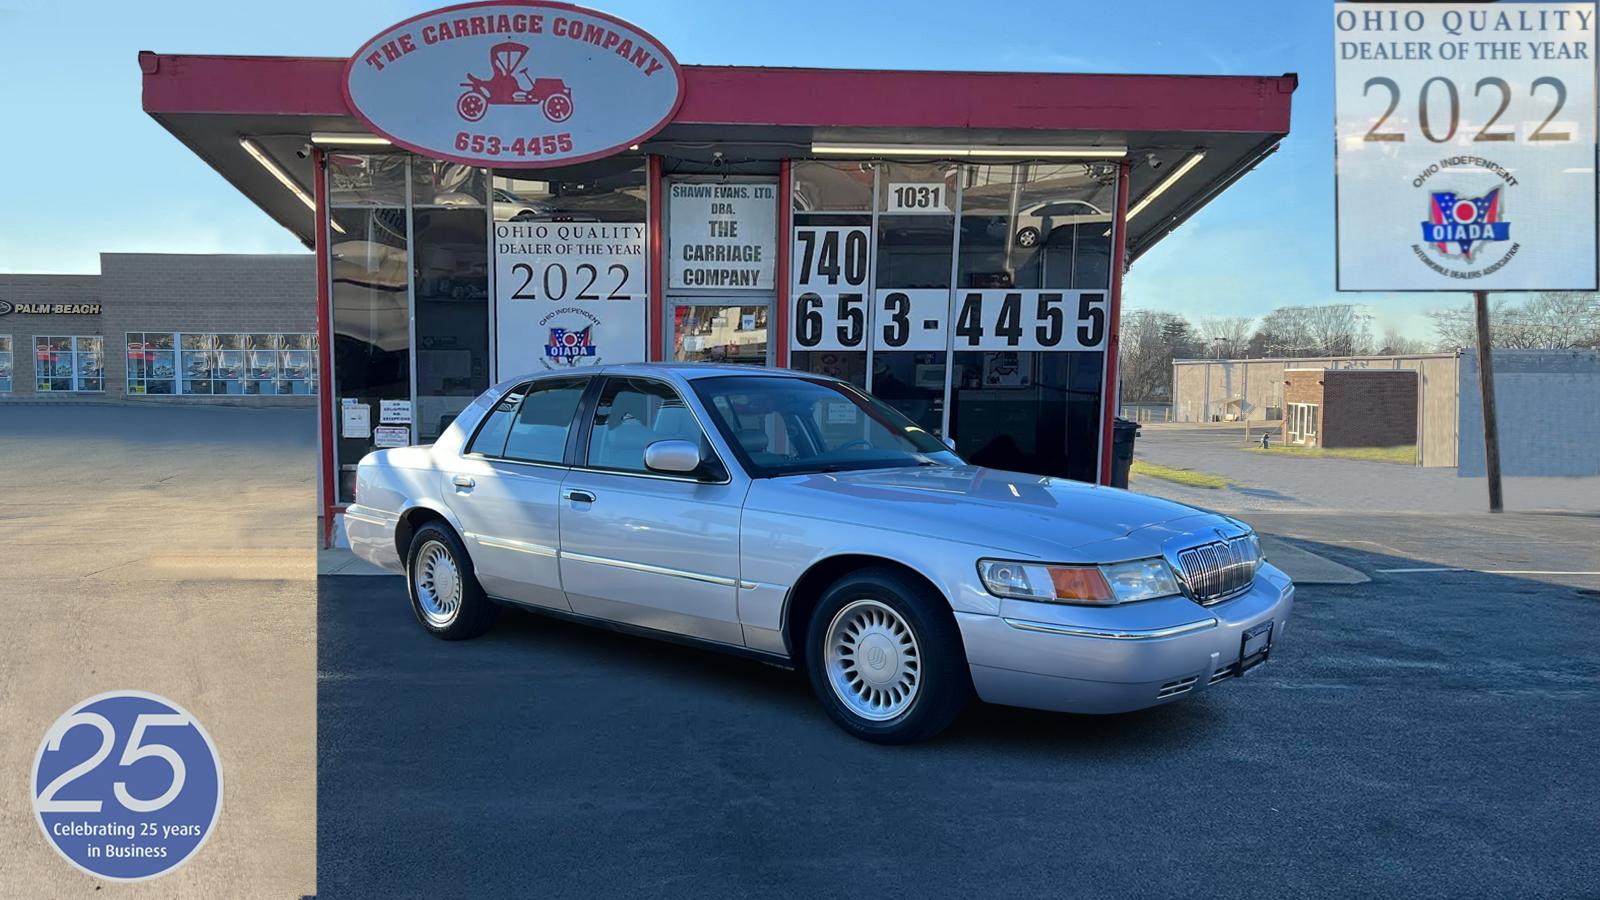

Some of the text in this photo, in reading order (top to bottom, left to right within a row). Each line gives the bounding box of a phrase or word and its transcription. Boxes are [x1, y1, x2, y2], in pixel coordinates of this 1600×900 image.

[1336, 10, 1592, 36] OHIO QUALITY
[365, 14, 664, 77] THE CARRIAGE COMPANY
[1341, 41, 1589, 60] DEALER OF THE YEAR
[1363, 76, 1571, 143] 2022
[454, 131, 574, 156] 653-4455
[1412, 155, 1519, 188] OHIO INDEPENDENT
[672, 185, 713, 199] SHAWN
[754, 187, 775, 200] LTD.
[894, 186, 941, 209] 1031
[711, 203, 736, 215] DBA.
[496, 225, 645, 241] OHIO QUALITY
[708, 220, 738, 238] THE
[1432, 224, 1495, 241] OIADA
[499, 242, 641, 255] DEALER OF THE YEAR
[682, 244, 762, 262] CARRIAGE
[798, 230, 868, 287] 740
[1410, 242, 1521, 280] AUTOMOBILE DEALERS ASSOCIATION
[510, 262, 632, 301] 2022
[683, 268, 760, 287] COMPANY
[14, 303, 101, 314] PALM BEACH
[539, 306, 602, 327] OHIO INDEPENDENT
[795, 291, 1105, 347] 653-4455
[550, 346, 588, 356] OIADA
